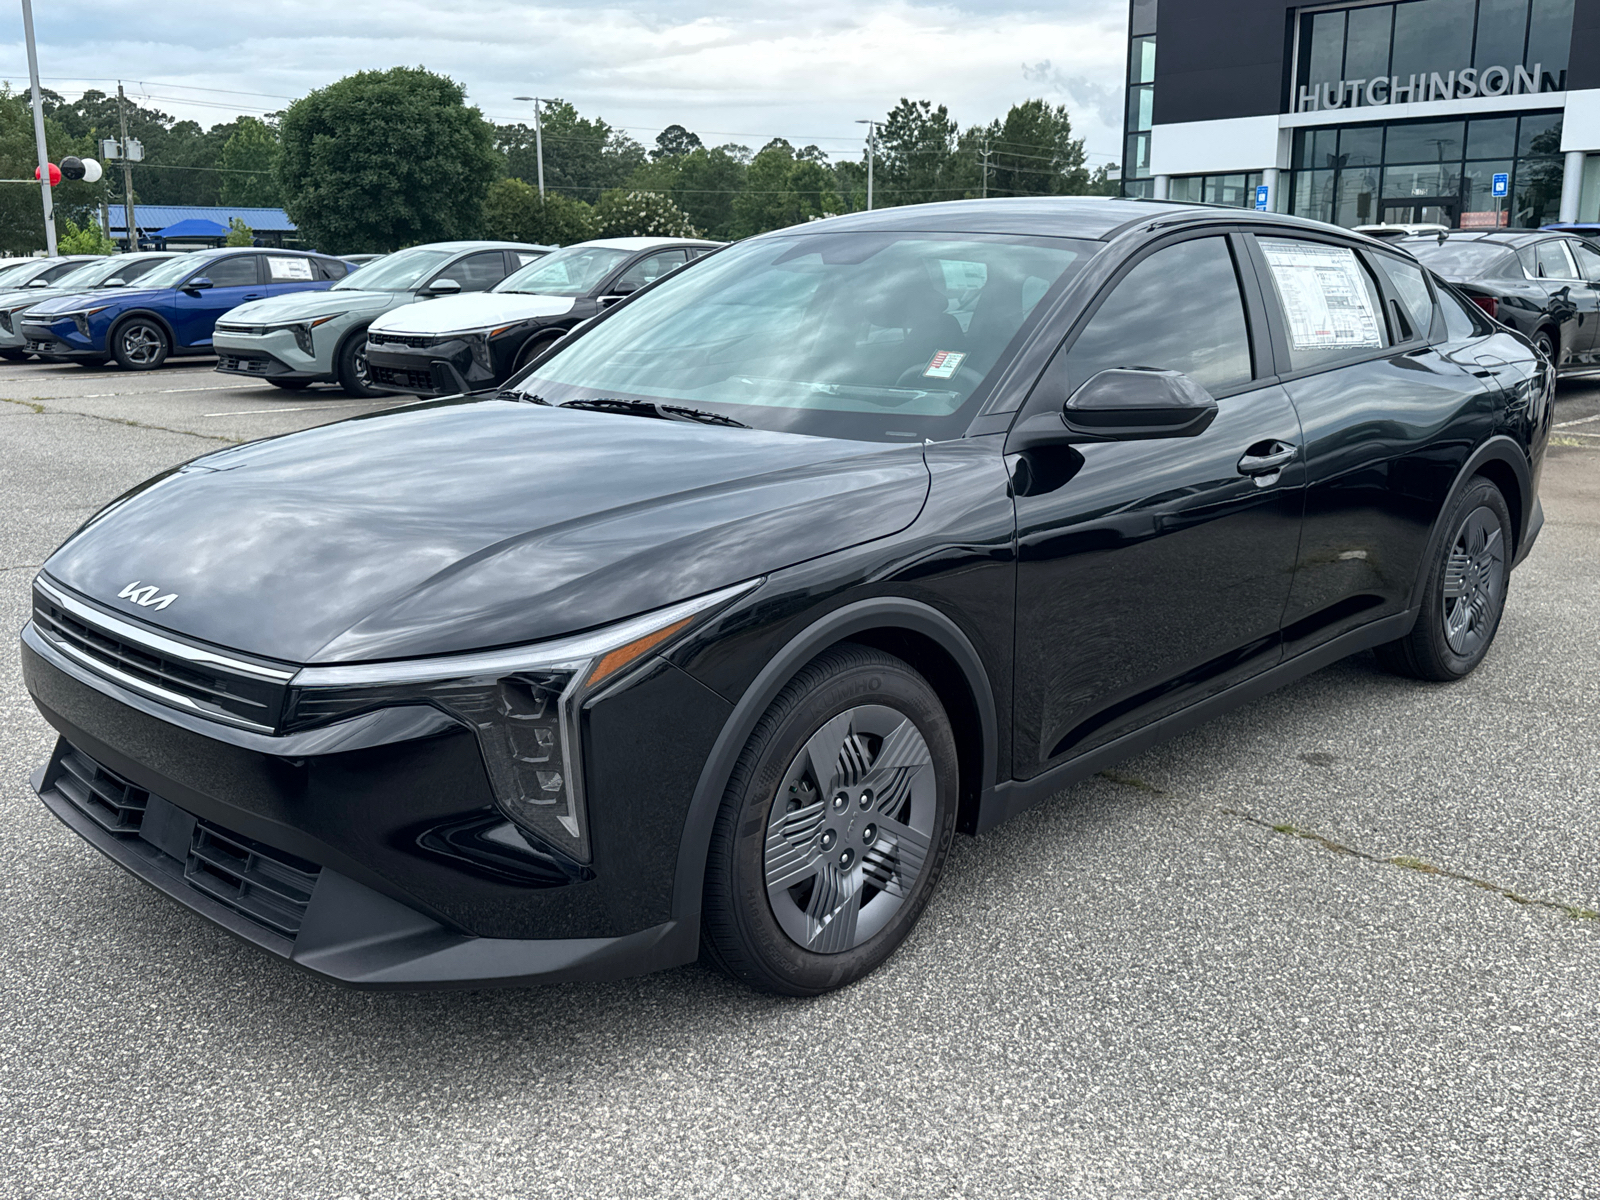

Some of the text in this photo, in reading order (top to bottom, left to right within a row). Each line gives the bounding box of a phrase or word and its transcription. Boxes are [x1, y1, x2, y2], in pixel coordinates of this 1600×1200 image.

[1299, 62, 1541, 114] HUTCHINSON
[117, 580, 179, 612] KIA
[809, 676, 883, 719] KUMHO
[921, 812, 954, 902] SOLUS
